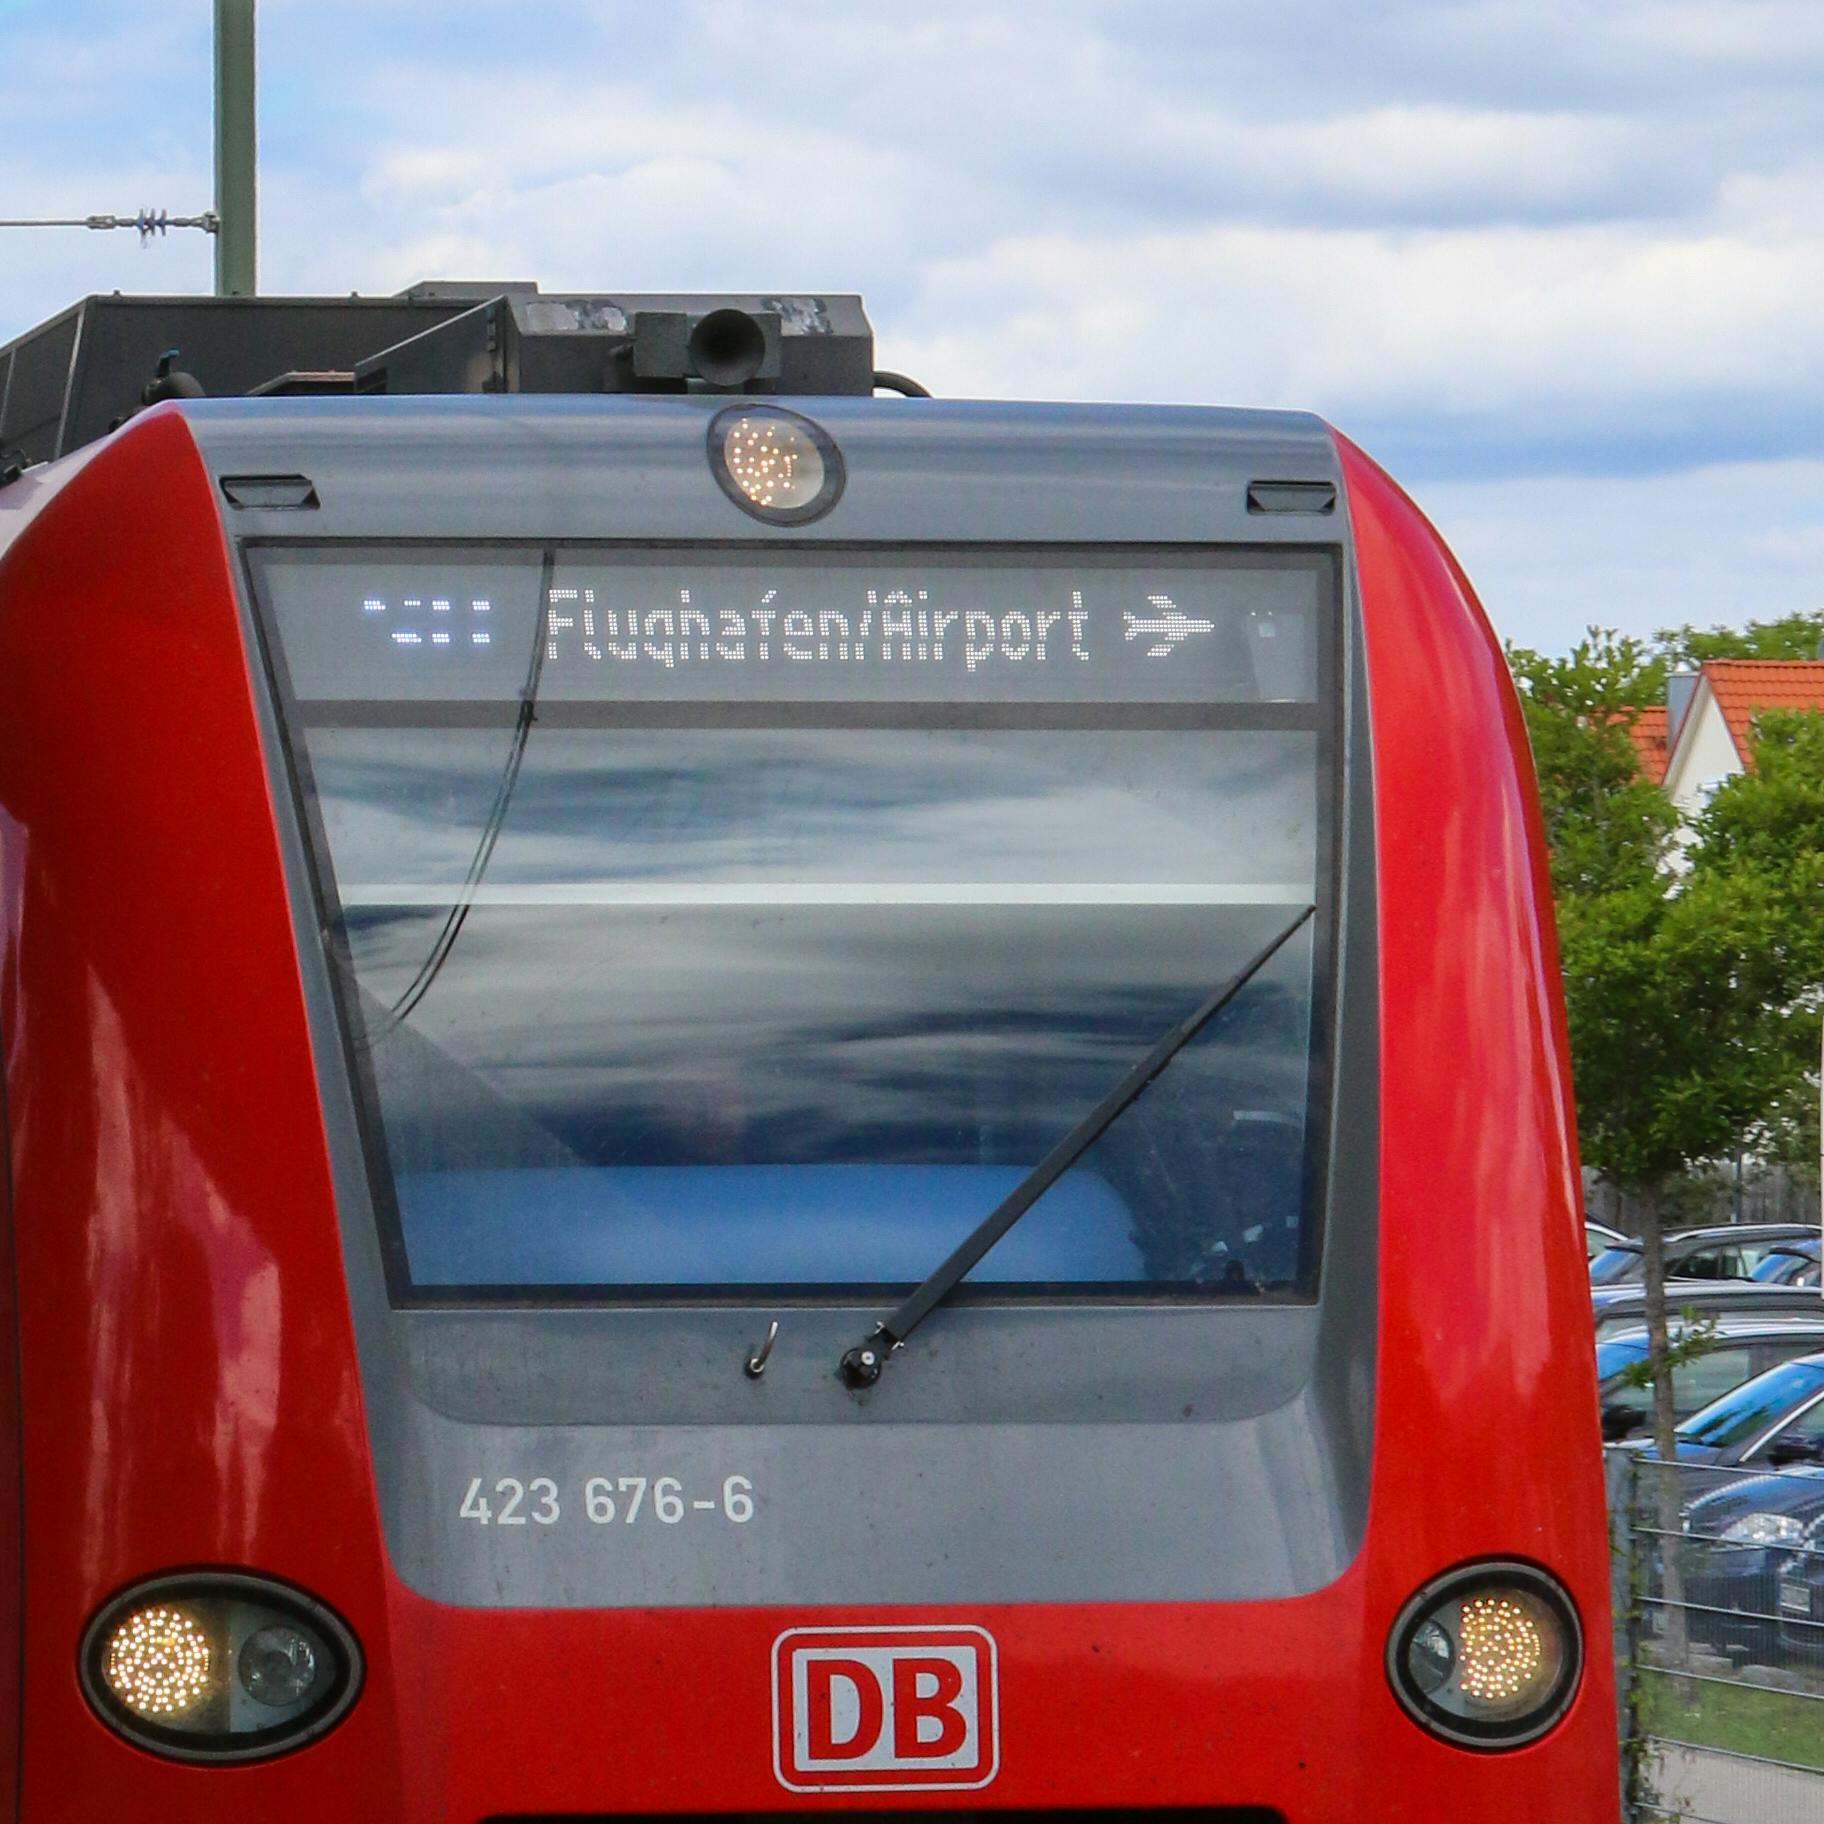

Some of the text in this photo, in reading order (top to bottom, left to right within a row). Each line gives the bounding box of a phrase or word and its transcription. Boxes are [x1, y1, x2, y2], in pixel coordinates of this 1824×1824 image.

[547, 588, 1091, 673] Flughafen/Airport
[459, 1475, 755, 1526] 423 676-6
[806, 1657, 968, 1761] DB
